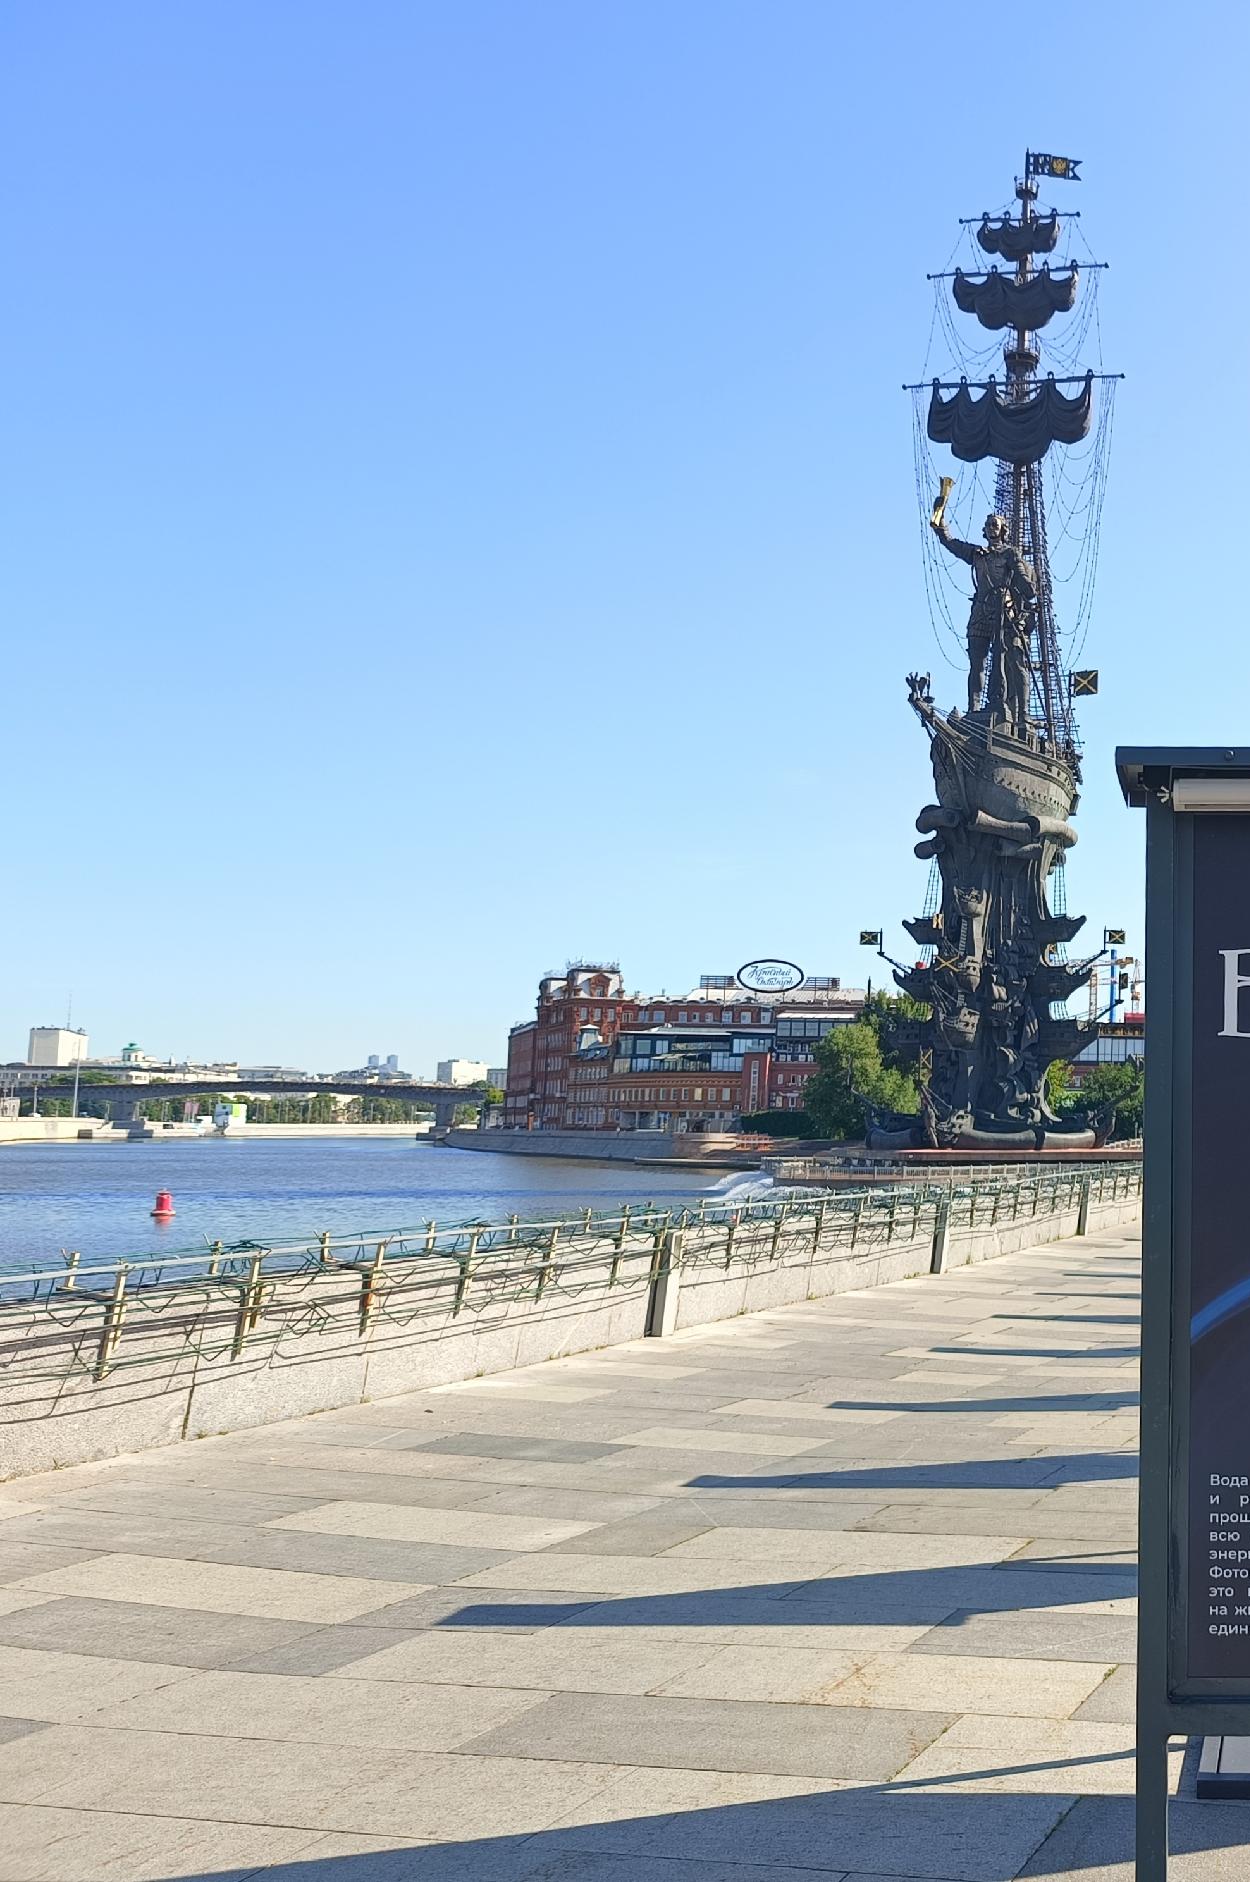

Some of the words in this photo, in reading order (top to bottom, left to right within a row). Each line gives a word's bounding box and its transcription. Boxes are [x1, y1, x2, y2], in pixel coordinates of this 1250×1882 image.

[1210, 1474, 1249, 1488] Вода
[1209, 1494, 1220, 1505] и
[1209, 1531, 1241, 1542] всю
[1208, 1586, 1234, 1597] это
[1209, 1605, 1228, 1616] на
